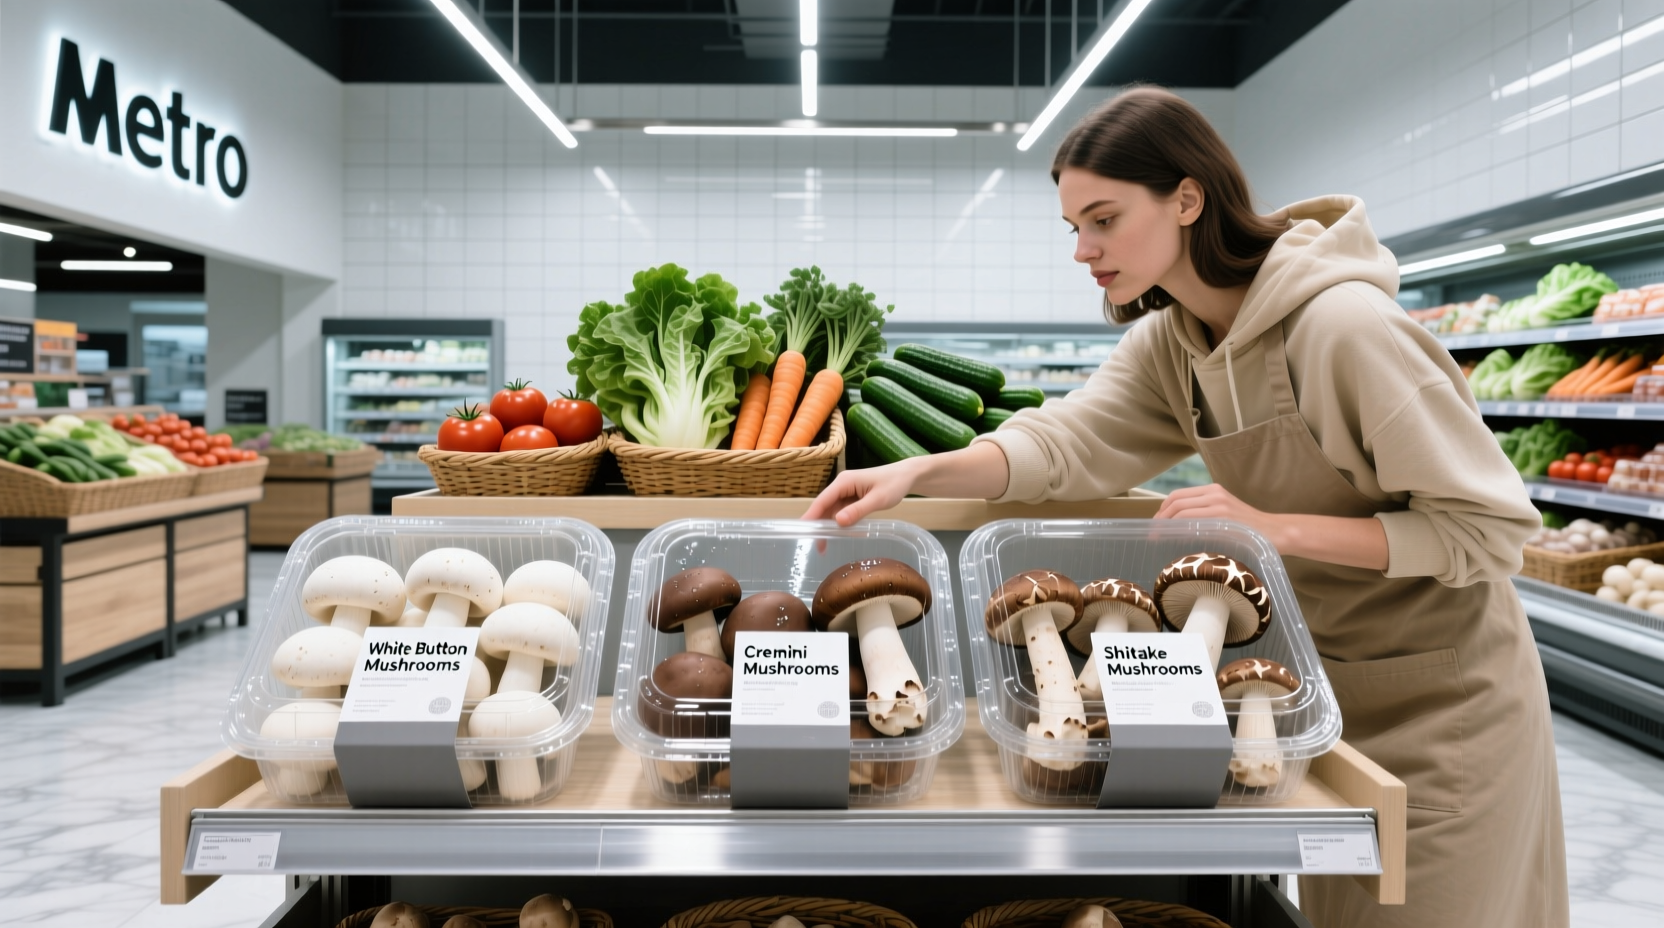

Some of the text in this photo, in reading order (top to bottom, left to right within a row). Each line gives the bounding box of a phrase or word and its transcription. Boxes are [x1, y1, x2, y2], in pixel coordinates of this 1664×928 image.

[49, 37, 247, 198] Metro
[369, 641, 468, 656] White Button
[744, 645, 807, 659] Cremini
[1104, 646, 1167, 660] Shitake
[364, 658, 460, 672] Mushrooms
[743, 661, 839, 675] Mushrooms
[1107, 662, 1203, 676] Mushrooms
